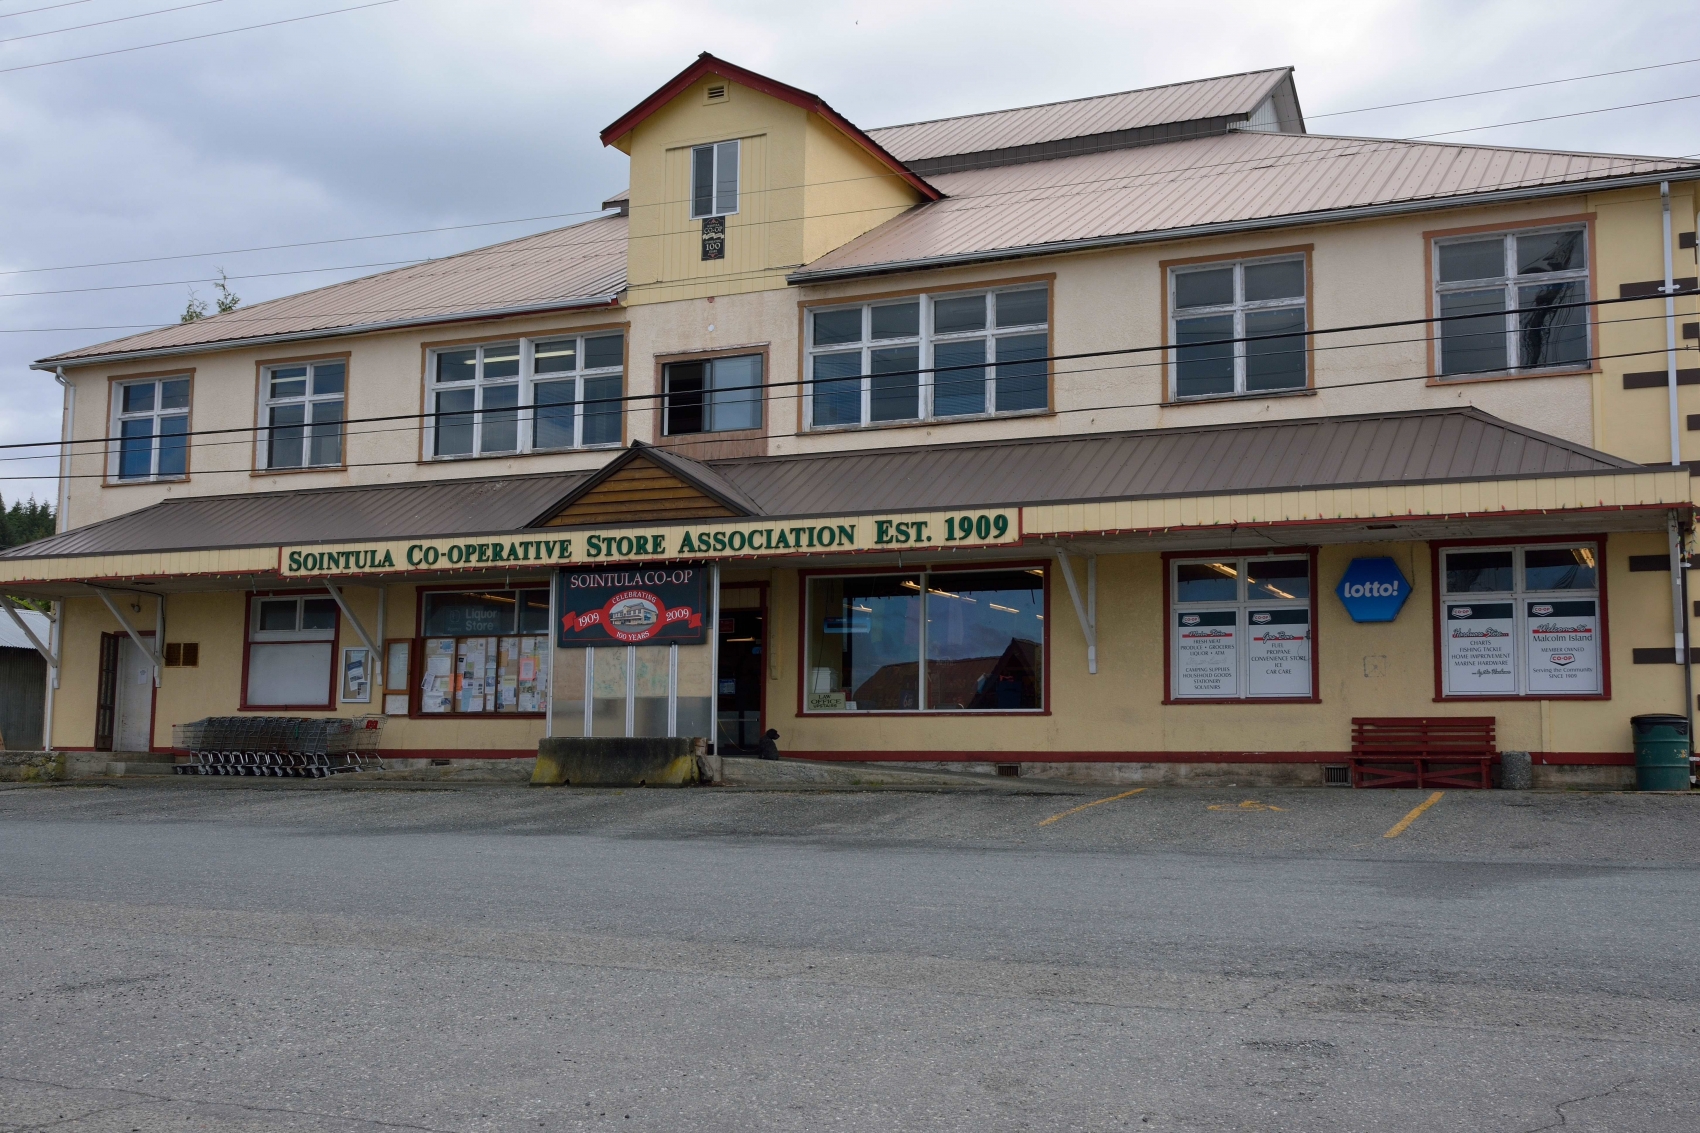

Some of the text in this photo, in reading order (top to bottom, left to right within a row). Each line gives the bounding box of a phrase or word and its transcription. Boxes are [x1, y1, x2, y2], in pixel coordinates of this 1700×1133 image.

[706, 242, 720, 250] 100
[288, 549, 395, 572] SOINTULA
[406, 539, 572, 566] CO-OPERATIVE
[586, 533, 665, 558] STORE
[678, 524, 856, 553] ASSOCIATION
[944, 514, 1009, 541] 1909
[570, 570, 692, 588] SOINTULA CO-OP
[1344, 580, 1398, 598] lotto!
[612, 591, 656, 604] CELEBRATING
[466, 608, 498, 621] Liquor
[578, 612, 600, 627] 1909
[666, 608, 689, 622] 2009
[466, 620, 494, 631] Store
[1537, 623, 1575, 632] Welcome
[616, 631, 650, 641] 100 YEARS
